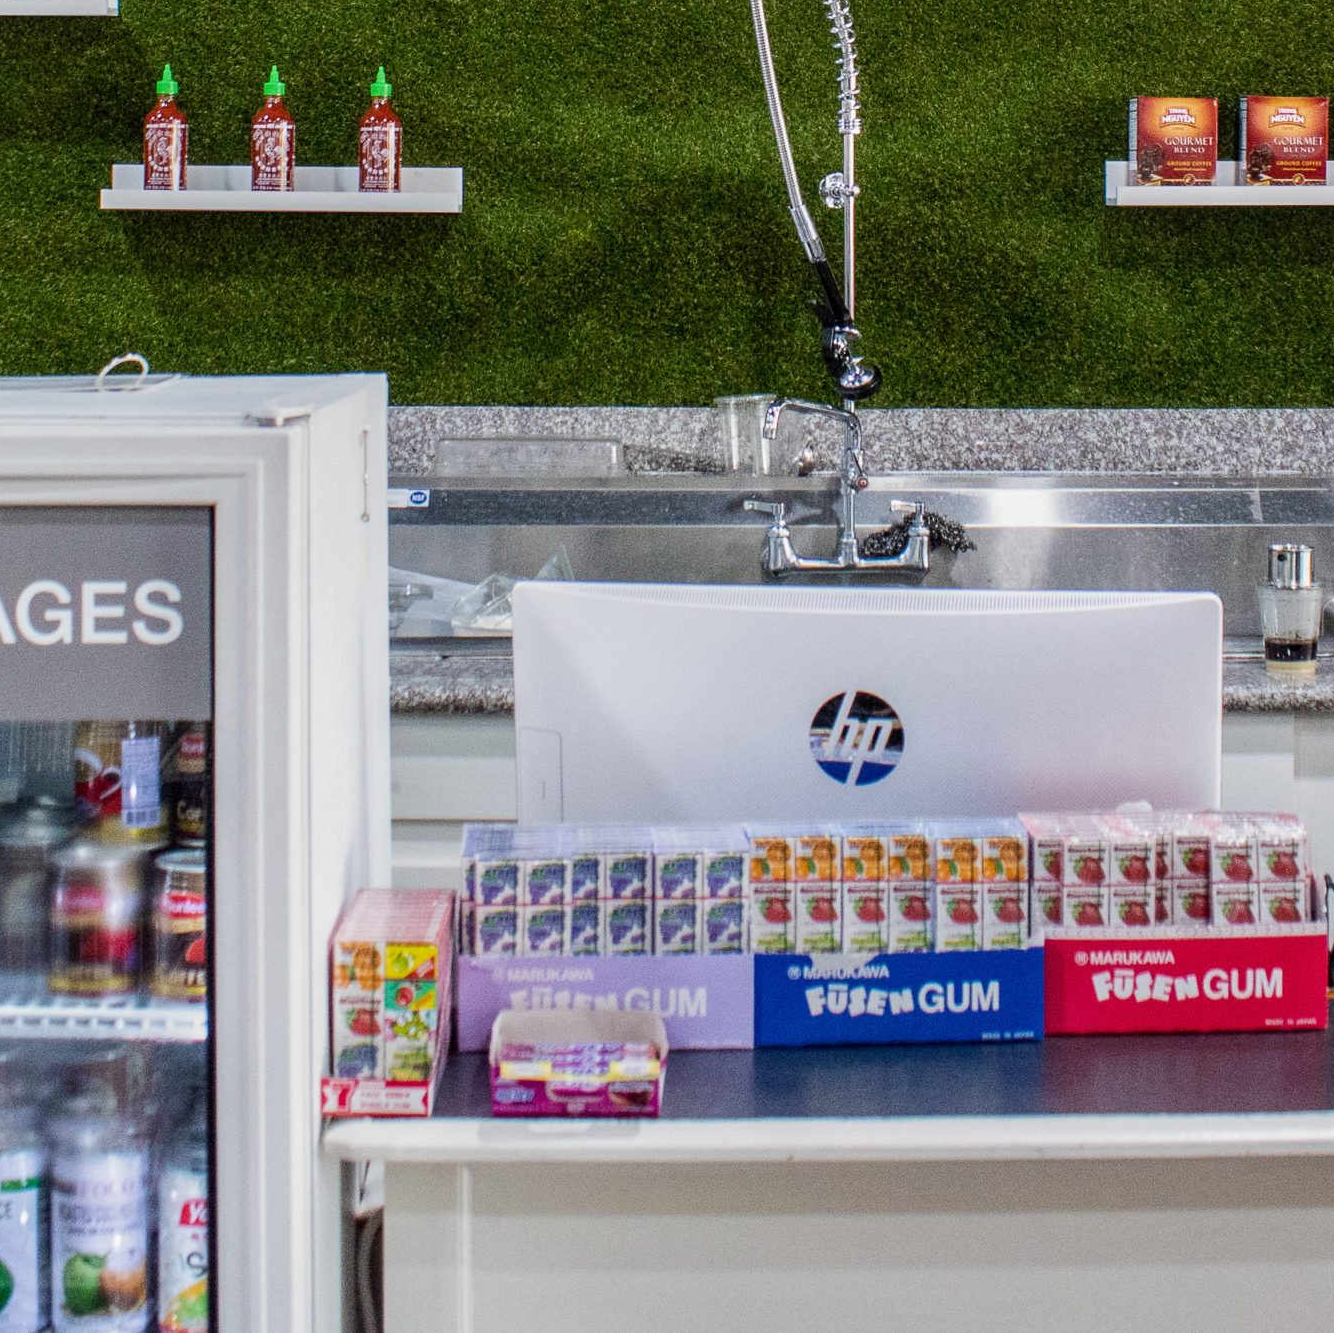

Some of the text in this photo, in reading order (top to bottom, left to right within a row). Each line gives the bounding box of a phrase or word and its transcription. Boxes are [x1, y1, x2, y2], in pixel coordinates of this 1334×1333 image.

[1164, 136, 1214, 146] GOURMET
[1274, 136, 1324, 146] GOURMET
[817, 690, 901, 786] hp
[1089, 950, 1176, 966] MARUKAWA
[507, 968, 594, 982] MARUKAWA
[803, 964, 890, 980] MARUKAWA
[1202, 967, 1284, 1001] GUM
[624, 986, 708, 1017] GUM
[917, 980, 1001, 1014] GUM
